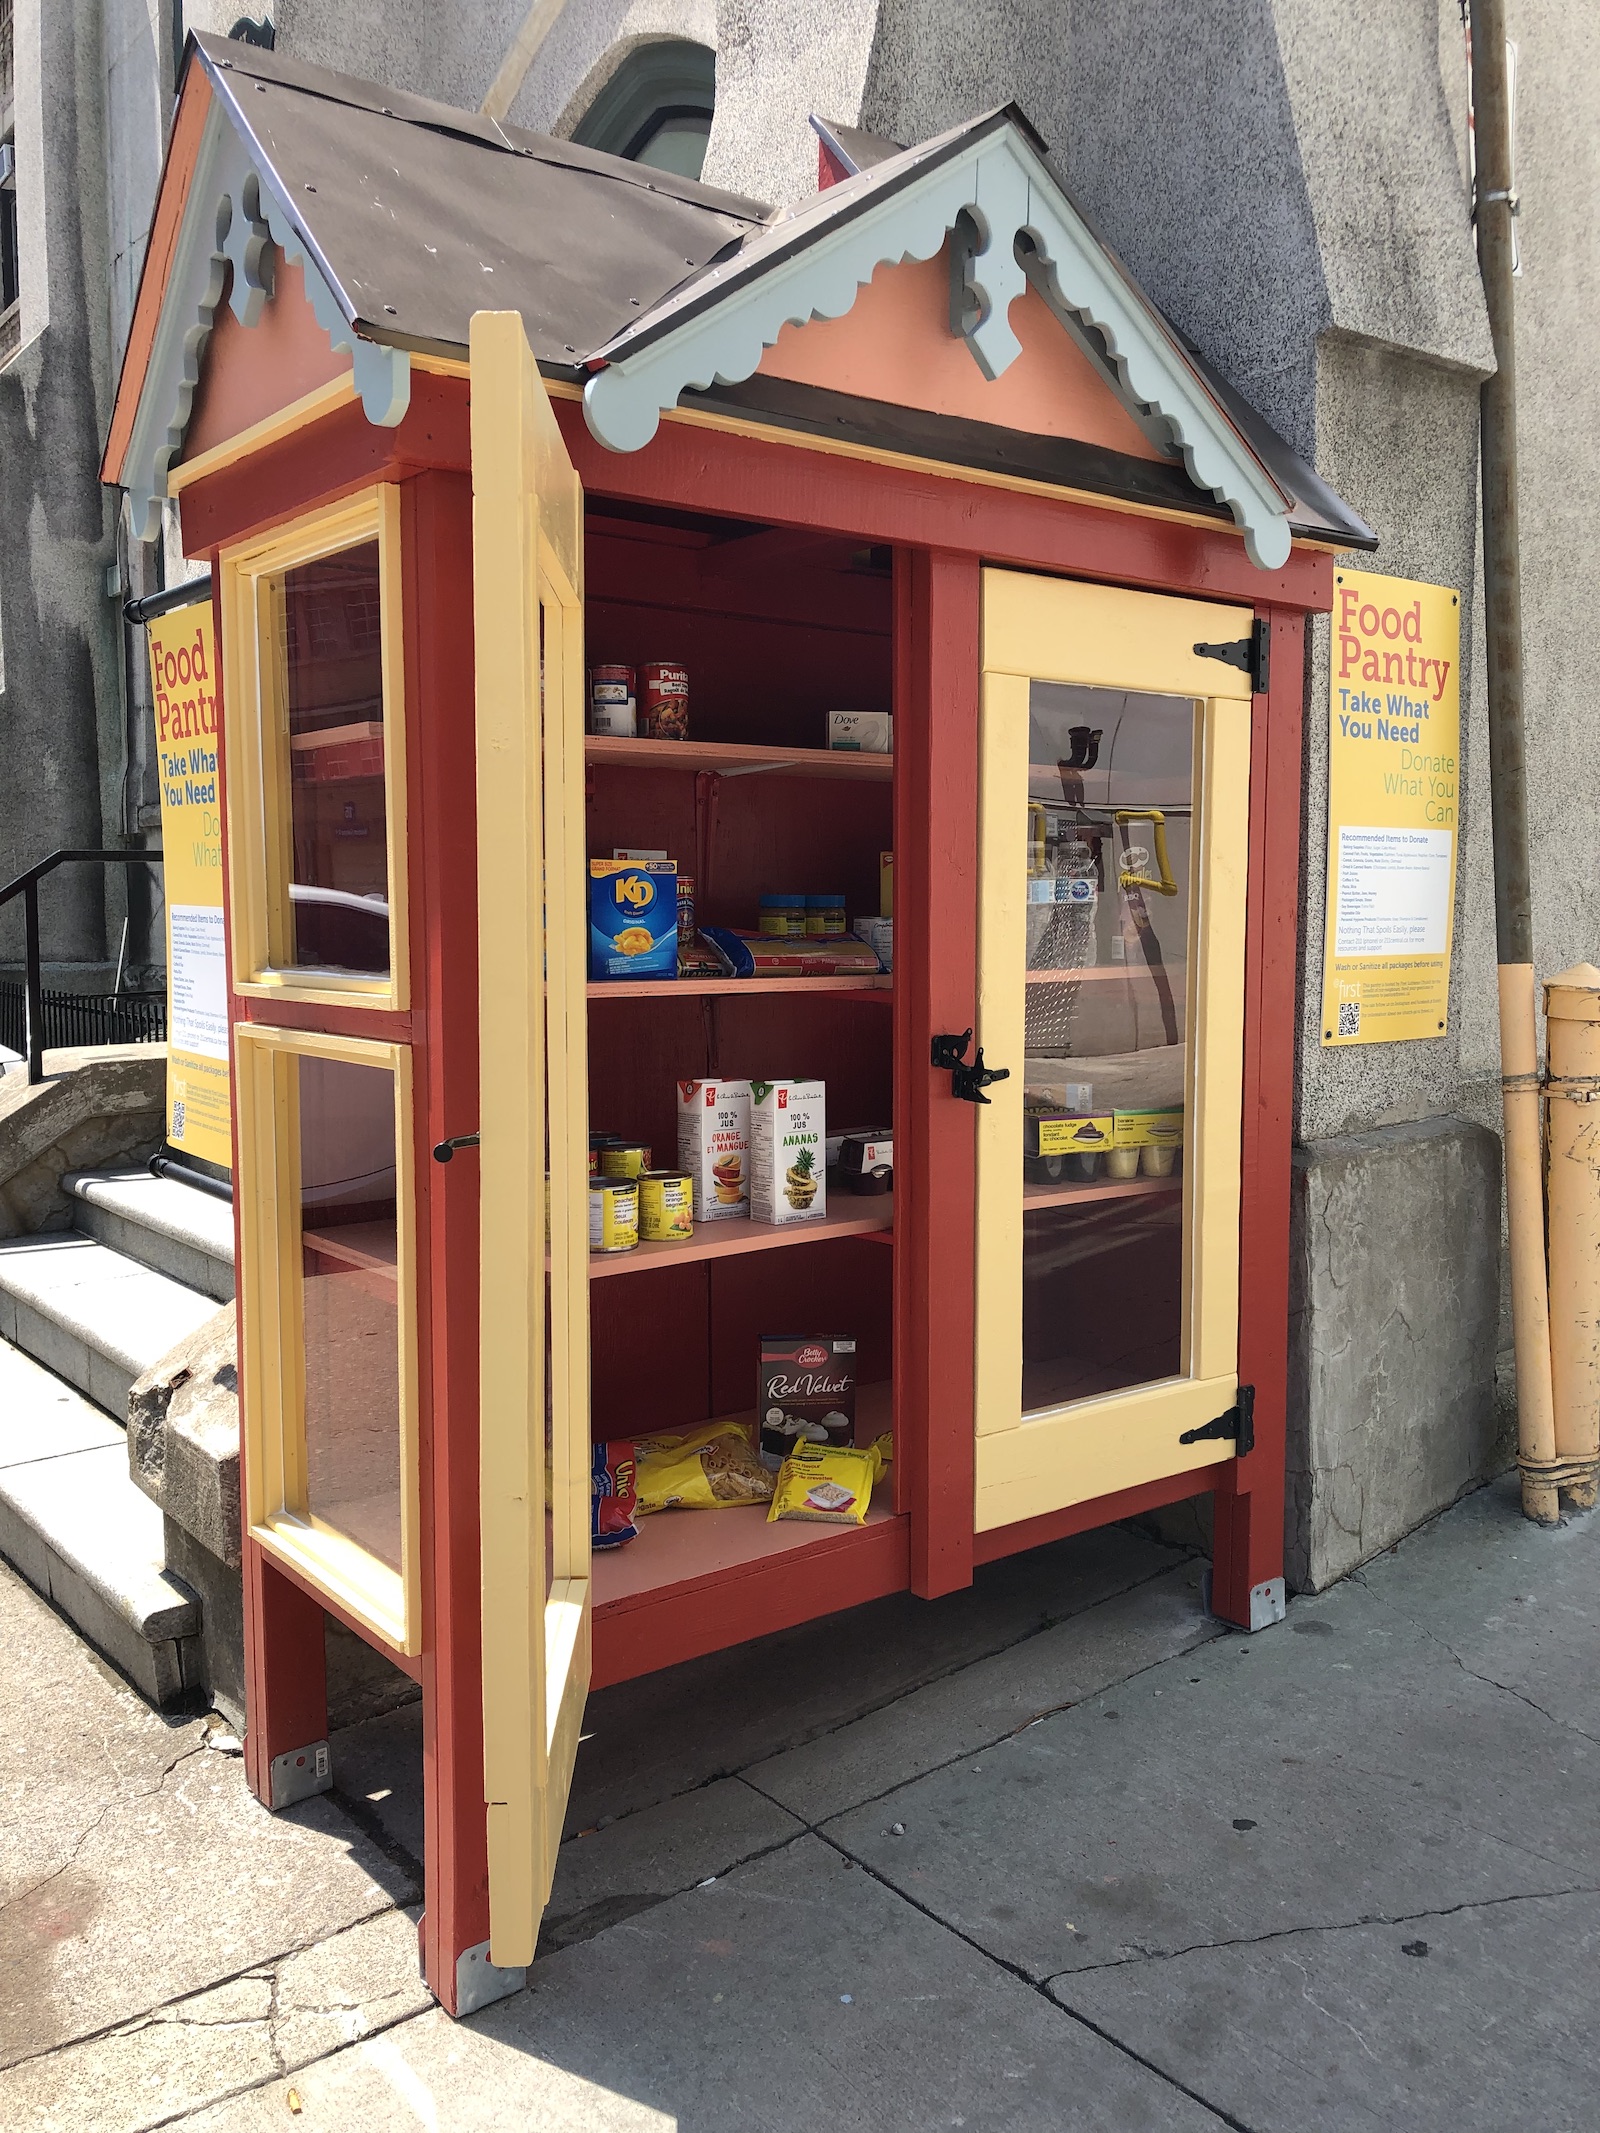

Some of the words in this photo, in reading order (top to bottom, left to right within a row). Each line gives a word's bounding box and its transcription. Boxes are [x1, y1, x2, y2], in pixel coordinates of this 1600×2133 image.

[1339, 588, 1422, 644] Food
[152, 628, 208, 691] Food
[1339, 634, 1450, 701] Pantry
[660, 669, 689, 683] Purit
[1339, 688, 1382, 715] Take
[1386, 693, 1430, 720] What
[157, 688, 218, 742] Pantr
[834, 713, 859, 725] Dove
[1339, 715, 1372, 739] You
[1378, 718, 1420, 744] Need
[161, 752, 187, 778] Take
[188, 747, 219, 774] Wha
[1401, 749, 1455, 774] Donate
[163, 782, 183, 807] You
[185, 777, 215, 805] Need
[1384, 773, 1423, 796] What
[1428, 776, 1454, 799] You
[1425, 801, 1453, 823] Can
[1341, 832, 1385, 842] Recommended
[1385, 834, 1401, 843] Items
[1409, 835, 1429, 844] Donate
[615, 875, 654, 909] KD
[1338, 926, 1361, 936] Nothing
[1362, 925, 1375, 934] That
[1376, 925, 1392, 934] Spoils
[1392, 925, 1408, 935] Easily,
[1409, 925, 1426, 934] please
[1335, 963, 1351, 971] Wash
[1359, 962, 1381, 970] Sanitize
[1389, 961, 1413, 970] packages
[718, 1112, 728, 1120] 100
[730, 1110, 738, 1119] %
[790, 1113, 801, 1121] 100
[803, 1112, 810, 1120] %
[720, 1119, 734, 1128] JUS
[793, 1121, 807, 1129] JUS
[712, 1131, 741, 1143] ORANGE
[783, 1132, 819, 1147] ANANAS
[707, 1146, 714, 1154] ET
[716, 1141, 749, 1153] MANGUE
[798, 1354, 826, 1364] Crocker
[803, 1347, 822, 1357] Betty
[767, 1374, 802, 1399] Red
[800, 1374, 854, 1396] Velvet
[821, 1447, 847, 1456] vegetable
